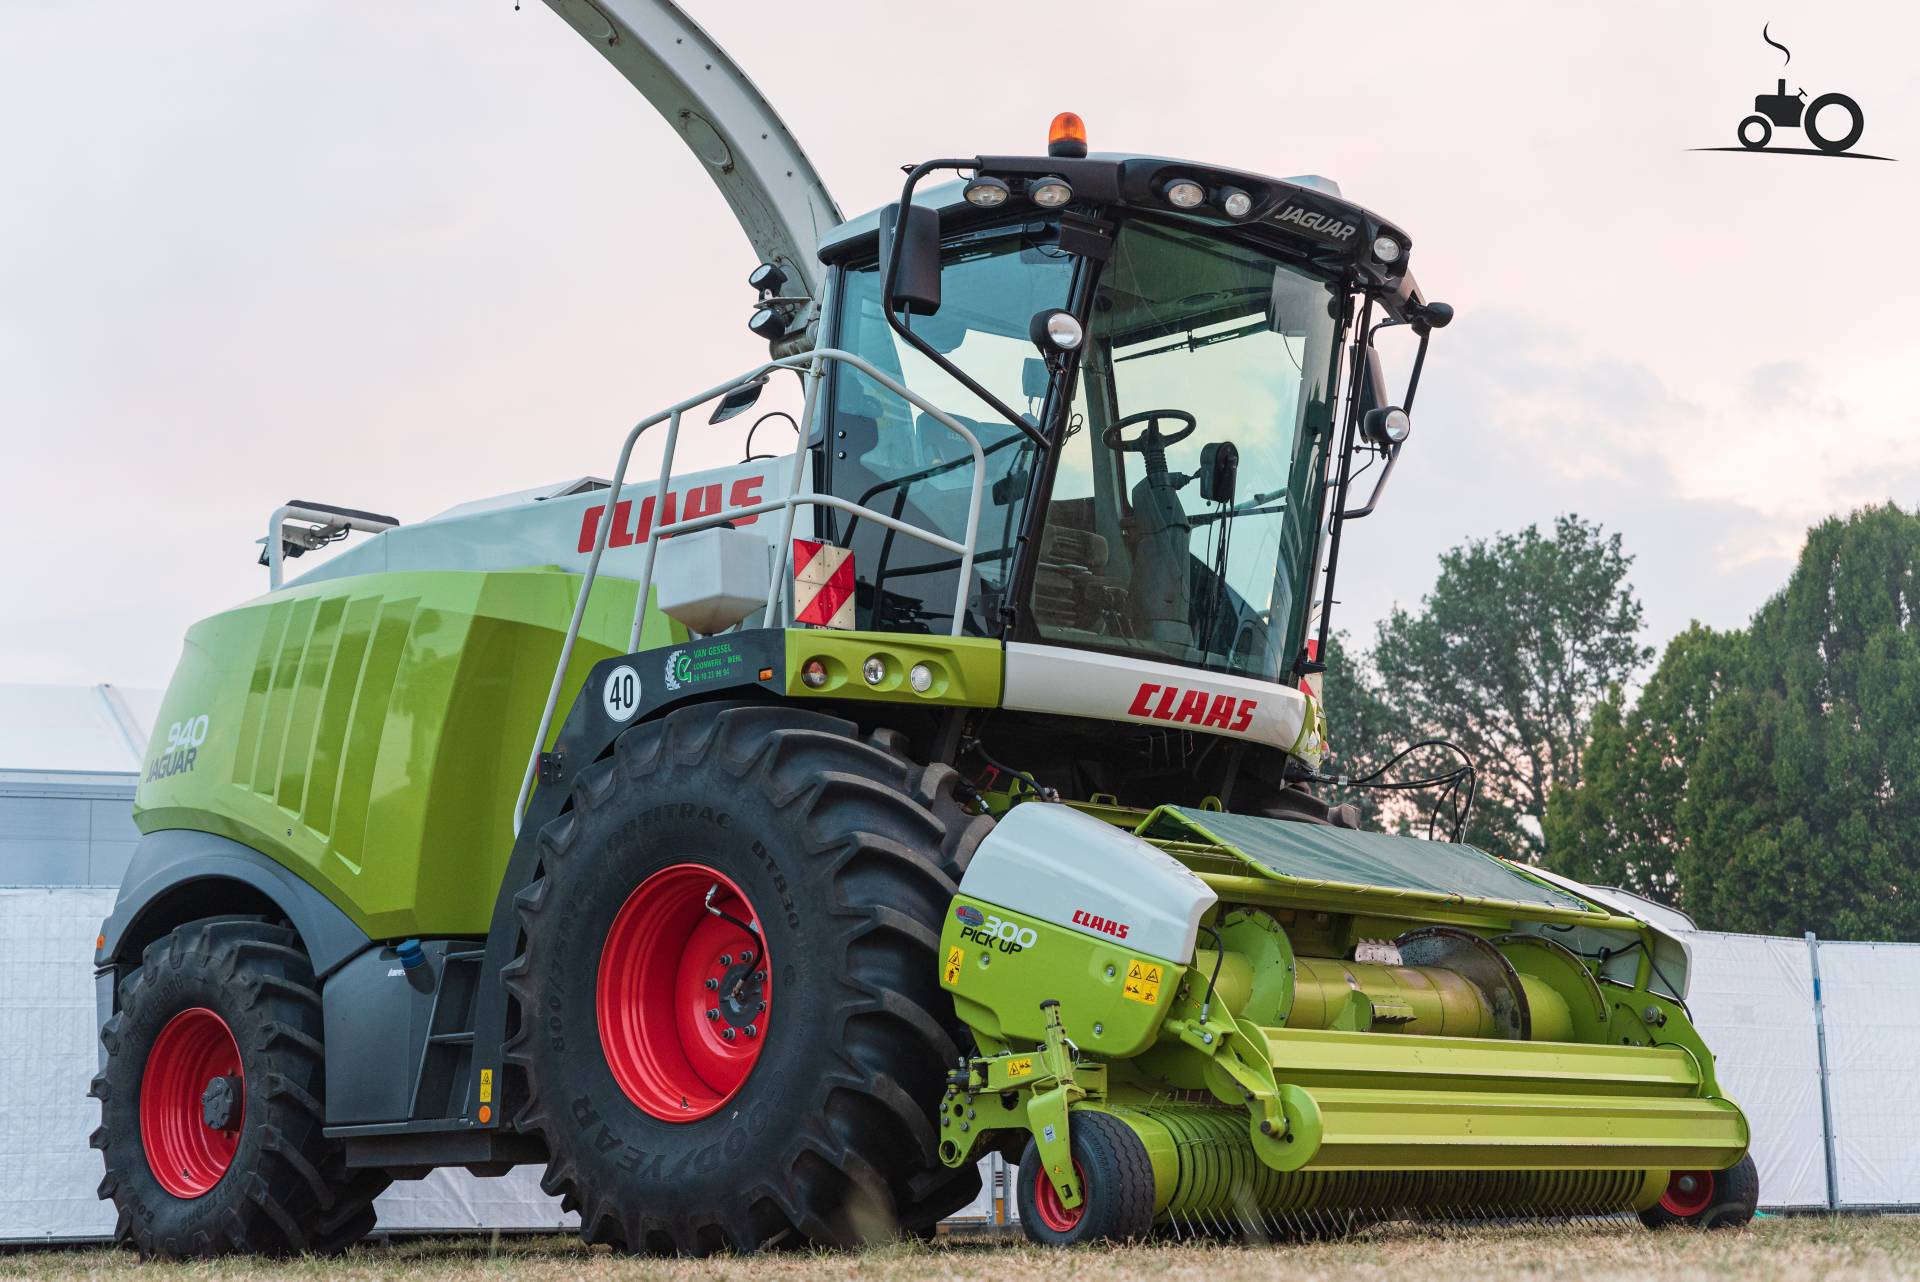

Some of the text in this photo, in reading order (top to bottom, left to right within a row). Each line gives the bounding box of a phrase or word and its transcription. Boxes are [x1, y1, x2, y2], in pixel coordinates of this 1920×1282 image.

[1275, 206, 1356, 240] JAGUAR
[577, 475, 764, 554] CLAAS
[693, 648, 707, 658] VAN
[610, 674, 634, 710] 40
[1128, 683, 1258, 732] CLAAS
[164, 714, 209, 755] 940
[146, 748, 197, 784] JAGUAR
[752, 840, 800, 929] DT830
[960, 926, 1023, 955] PICK UP
[982, 915, 1038, 949] 300
[1072, 910, 1130, 939] CLAAS
[571, 1070, 786, 1183] GOODYEAR
